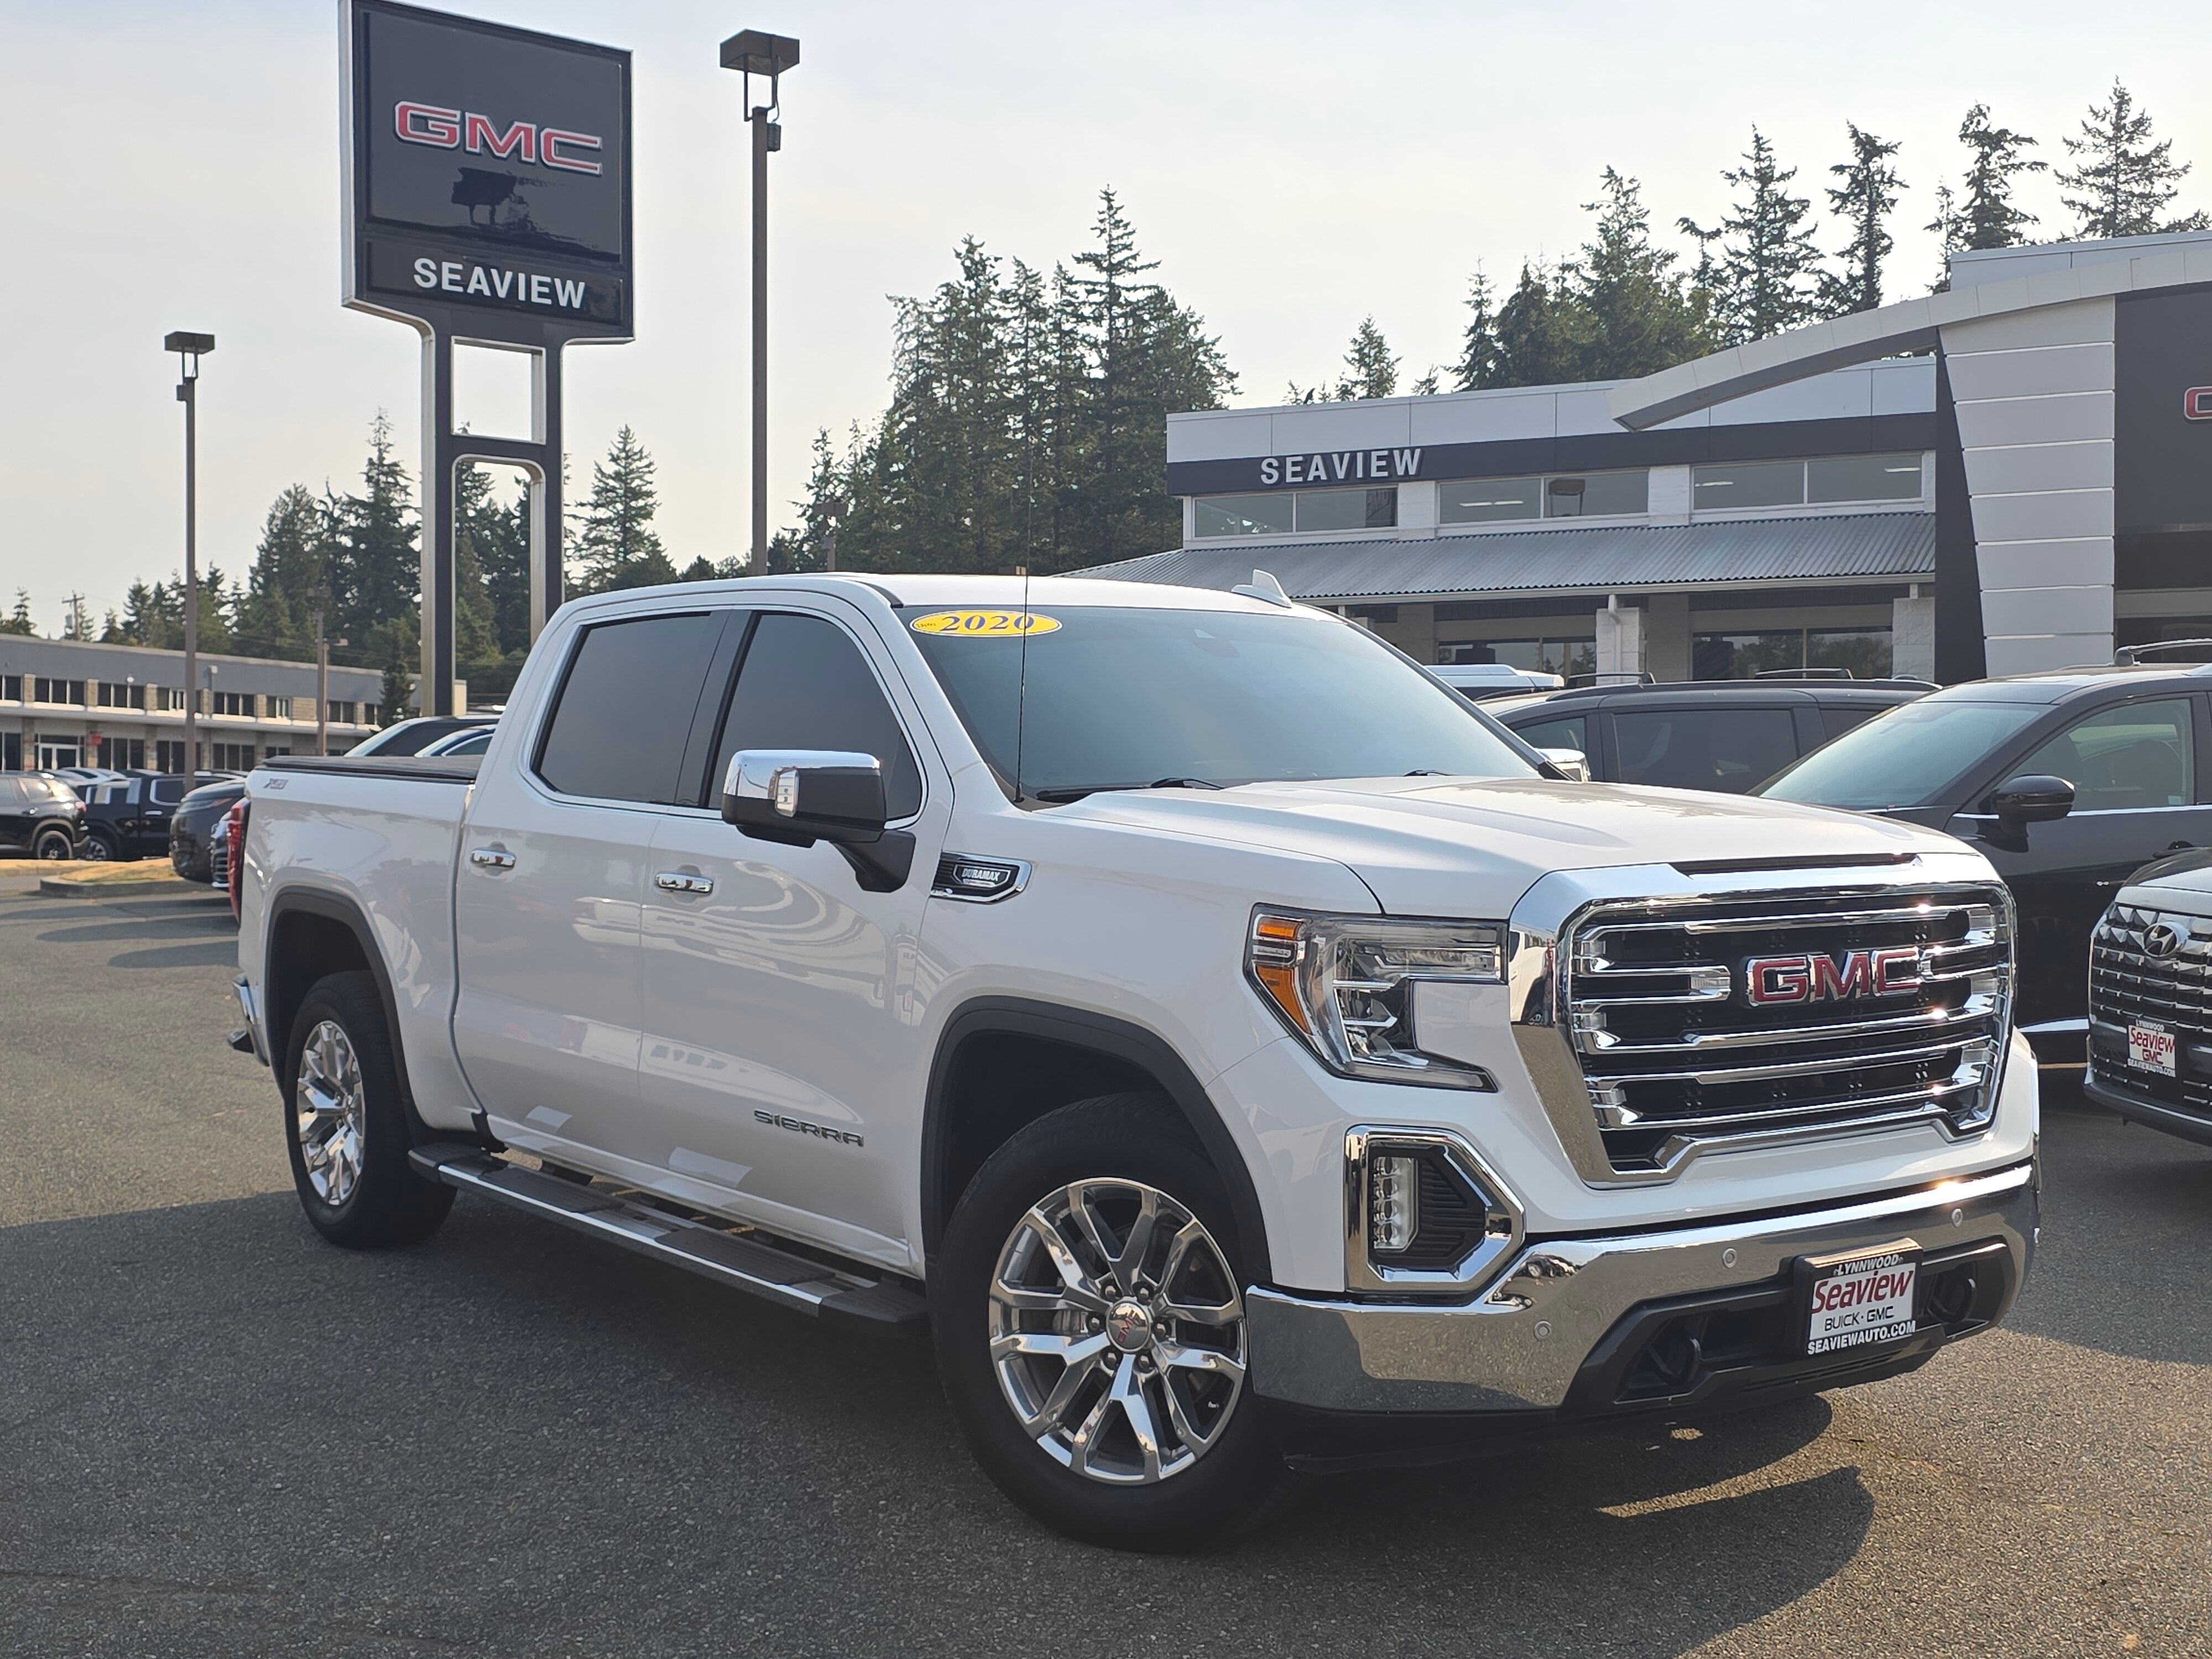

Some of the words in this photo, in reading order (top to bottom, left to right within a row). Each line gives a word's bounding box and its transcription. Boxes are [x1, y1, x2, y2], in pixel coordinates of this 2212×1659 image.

[394, 101, 602, 175] GMC
[413, 258, 586, 309] SEAVIEW
[1260, 448, 1421, 484] SEAVIEW
[940, 615, 1035, 632] 2020
[962, 868, 1000, 881] DURAMAX
[1746, 946, 1920, 1007] GMC
[2130, 1026, 2176, 1053] Seaview
[2142, 1048, 2164, 1065] GMC
[754, 1108, 864, 1147] SIERRA
[1838, 1254, 1900, 1276] LYNNWOOD
[1811, 1270, 1914, 1314] Seaview
[1824, 1311, 1861, 1332] BUICK
[1866, 1306, 1895, 1323] GMC
[1807, 1320, 1916, 1355] SEAVIEWAUTO.COM
